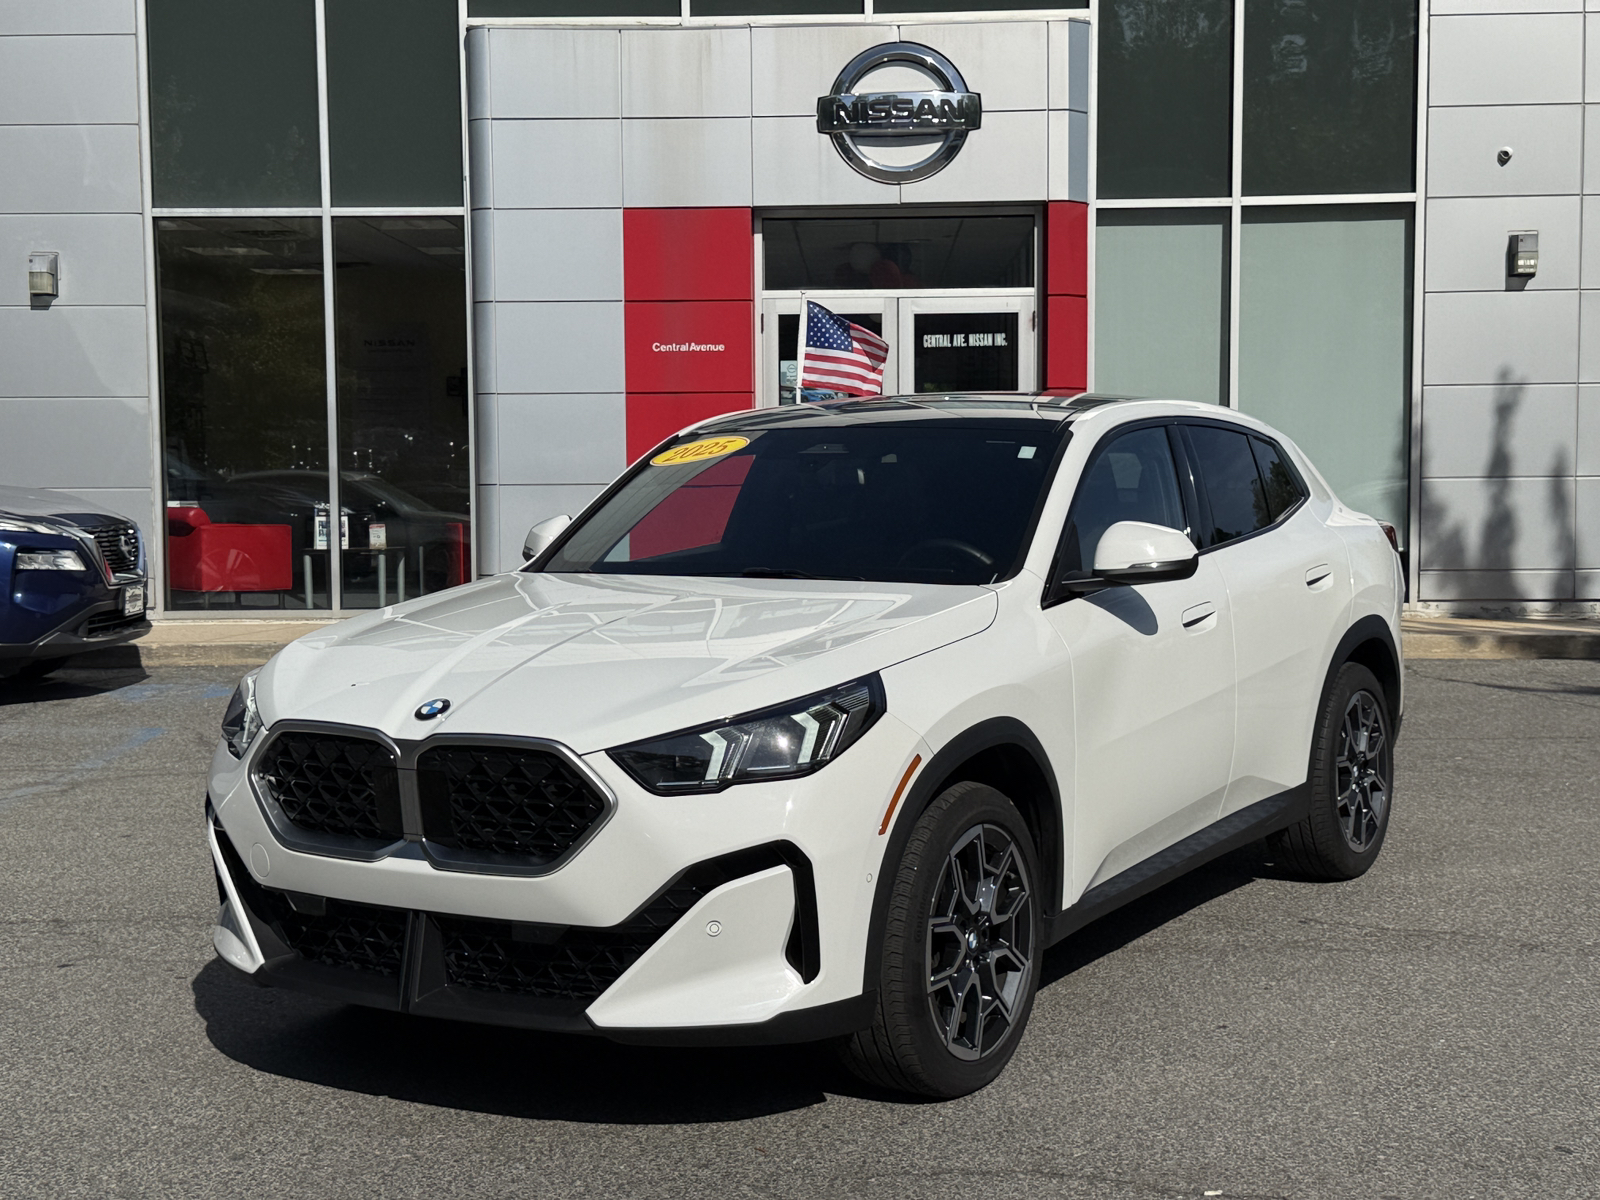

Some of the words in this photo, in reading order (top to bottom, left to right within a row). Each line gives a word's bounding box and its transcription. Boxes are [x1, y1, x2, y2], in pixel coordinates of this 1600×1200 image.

[833, 98, 965, 124] NISSAN
[363, 339, 416, 347] NISSAN
[652, 342, 689, 352] Central
[689, 342, 725, 352] Avenue
[923, 334, 951, 348] CENTRAL
[953, 333, 967, 347] AVE.
[968, 333, 993, 347] NISSAN
[662, 439, 737, 463] 2025
